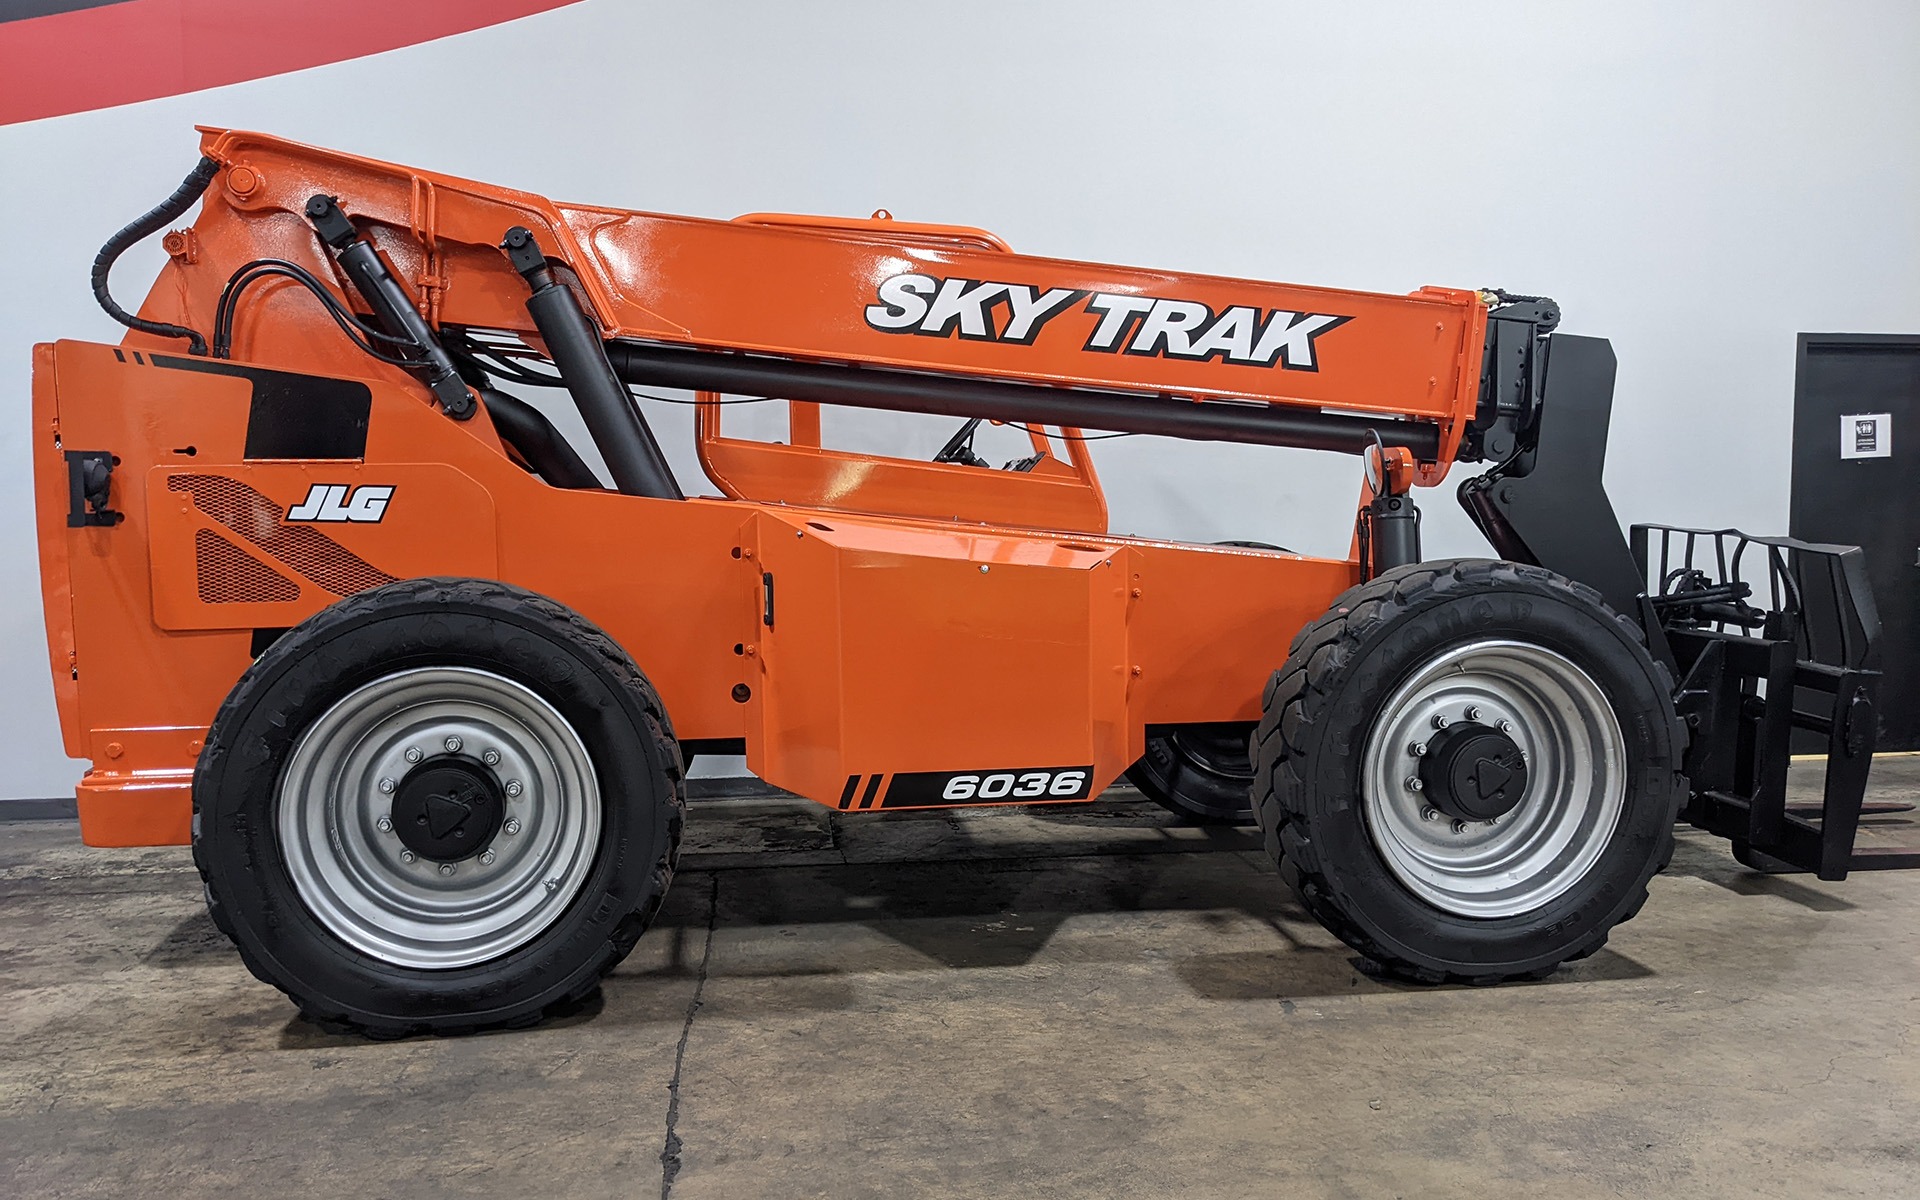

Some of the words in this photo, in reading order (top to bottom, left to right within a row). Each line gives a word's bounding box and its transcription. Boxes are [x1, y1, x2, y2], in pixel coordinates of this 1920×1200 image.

[864, 273, 1079, 344] SKY
[1086, 292, 1346, 370] TRAK
[286, 484, 395, 522] JLG
[942, 771, 1087, 800] 6036
